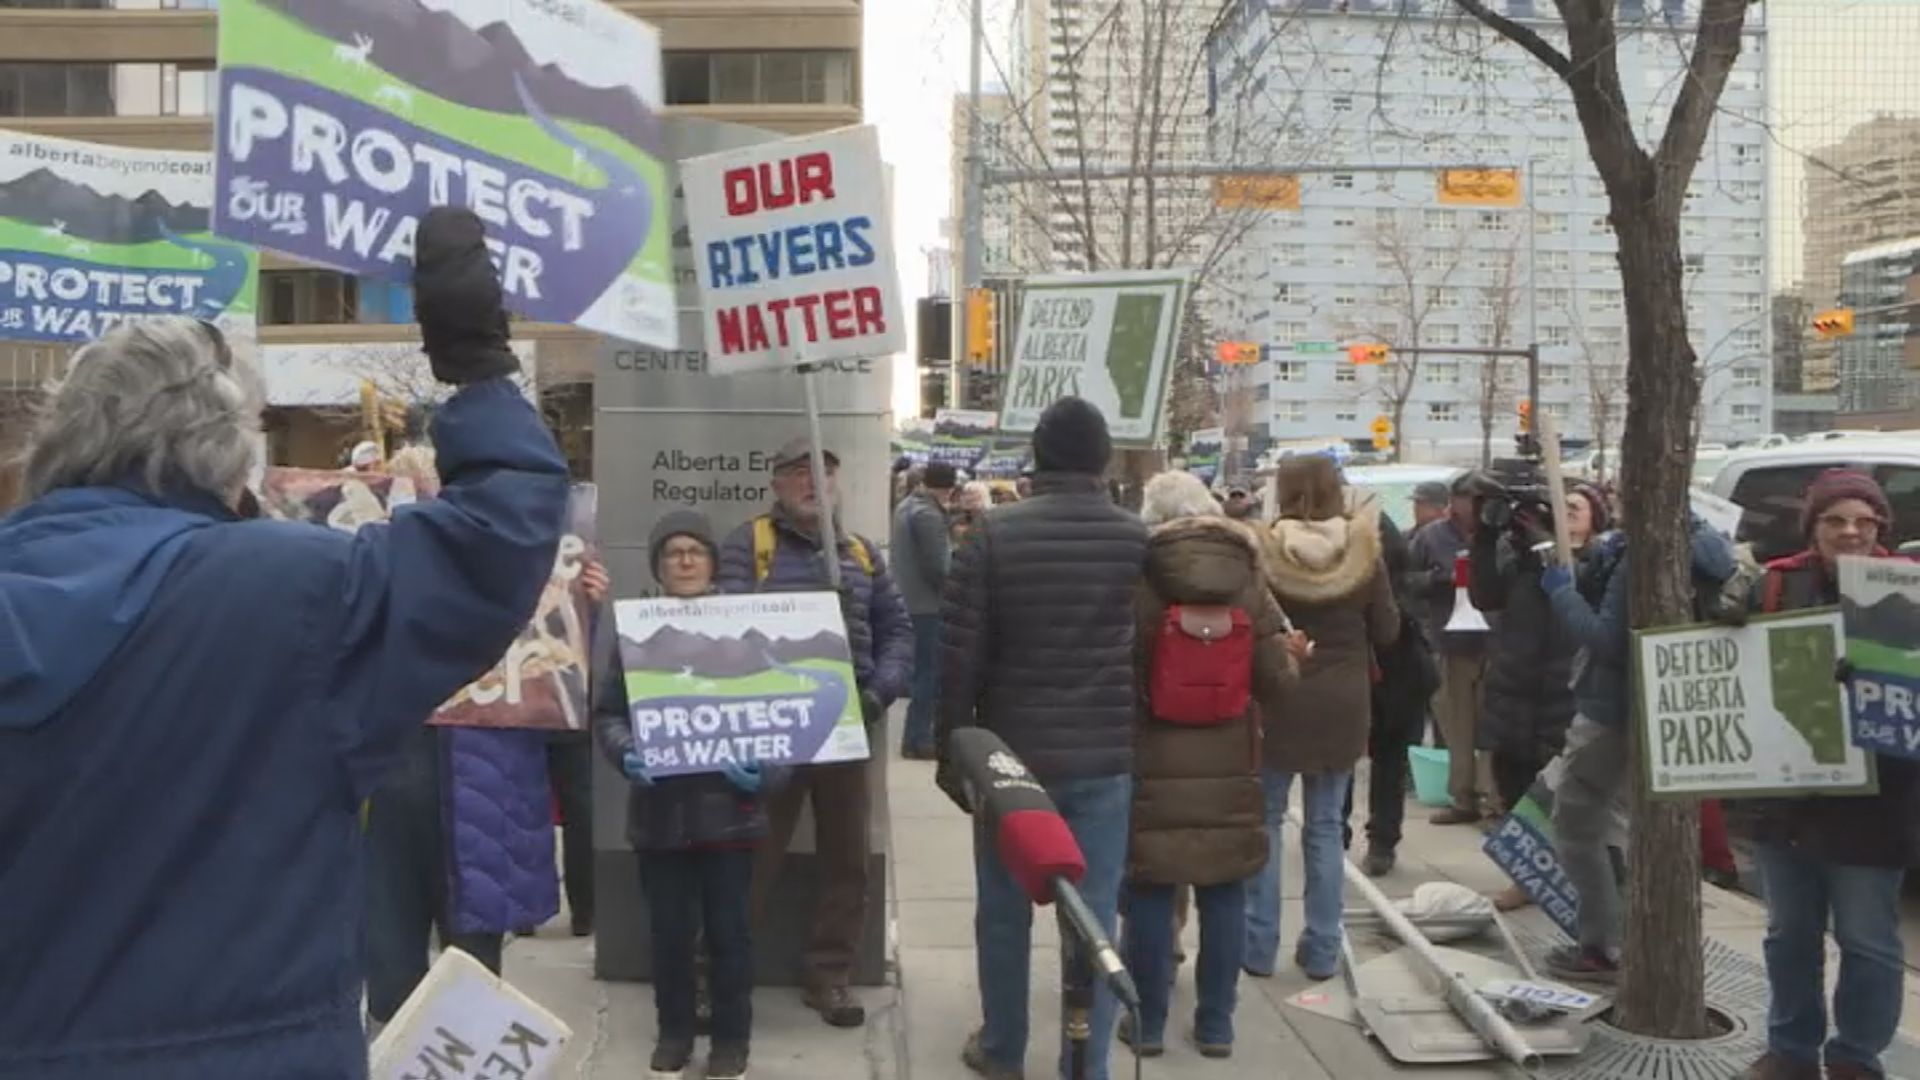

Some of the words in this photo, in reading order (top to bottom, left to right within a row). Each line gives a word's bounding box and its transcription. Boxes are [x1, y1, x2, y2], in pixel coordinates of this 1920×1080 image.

[228, 82, 595, 251] PROTECT
[723, 151, 835, 217] OUR
[228, 184, 306, 226] OUR
[321, 192, 543, 299] WAR
[706, 215, 876, 289] RIVERS
[716, 285, 886, 355] MATTER
[1028, 297, 1095, 329] DEFEND
[614, 351, 708, 371] CENTE
[1020, 332, 1088, 362] ALBERTA
[1011, 365, 1083, 408] PARKS
[652, 450, 740, 472] Alberta
[652, 479, 769, 505] Regulator
[1655, 637, 1739, 678] DEFEND
[1657, 676, 1746, 714] ALBERTA
[1854, 678, 1920, 720] PR
[635, 698, 814, 743] PROTECT
[1658, 712, 1753, 767] PARKS
[682, 733, 793, 765] WATER
[1501, 818, 1579, 902] PROTE
